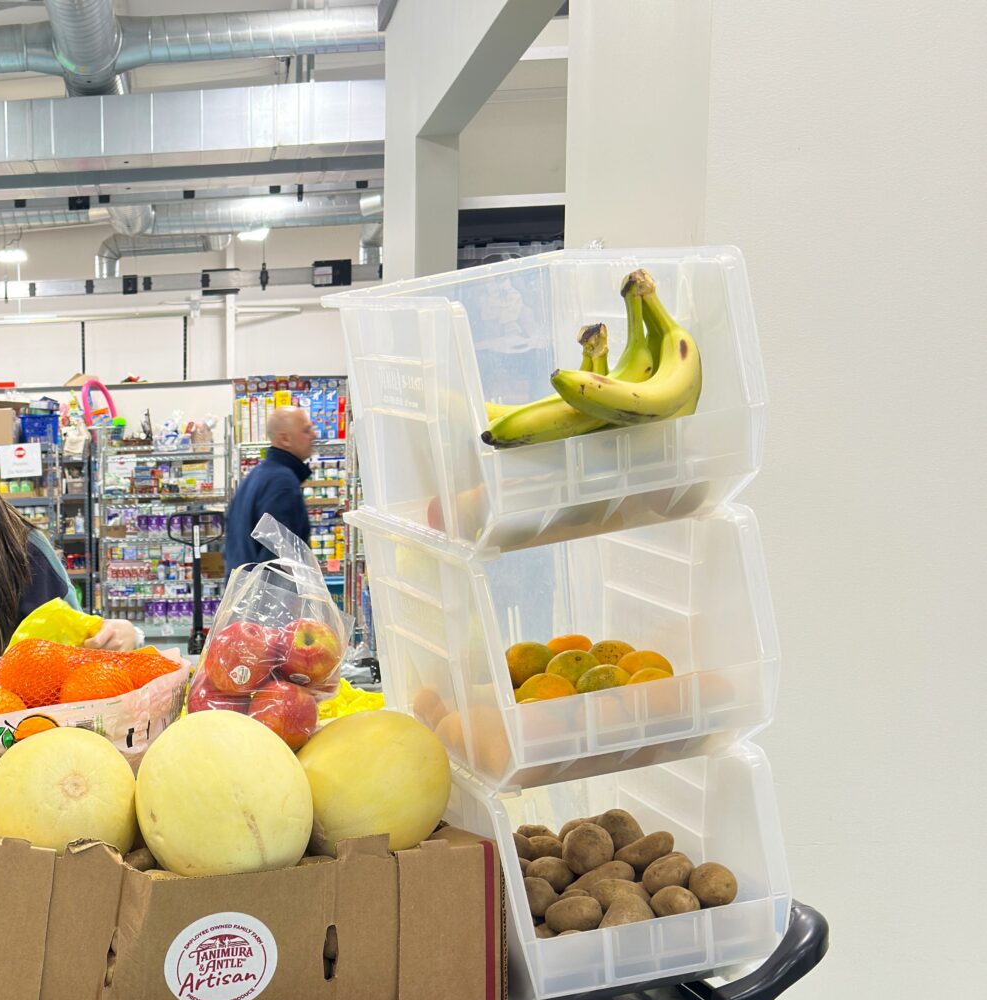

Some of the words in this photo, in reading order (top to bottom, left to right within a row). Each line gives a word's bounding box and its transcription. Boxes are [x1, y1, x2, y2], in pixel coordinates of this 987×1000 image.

[184, 928, 209, 950] EMPLOYEE
[210, 923, 233, 931] OWNED
[233, 924, 252, 934] FAMILY
[251, 931, 263, 945] FARM
[188, 946, 254, 967] TANIMURA
[199, 958, 244, 976] ANTLE
[198, 964, 205, 972] &
[179, 971, 257, 997] Artisan
